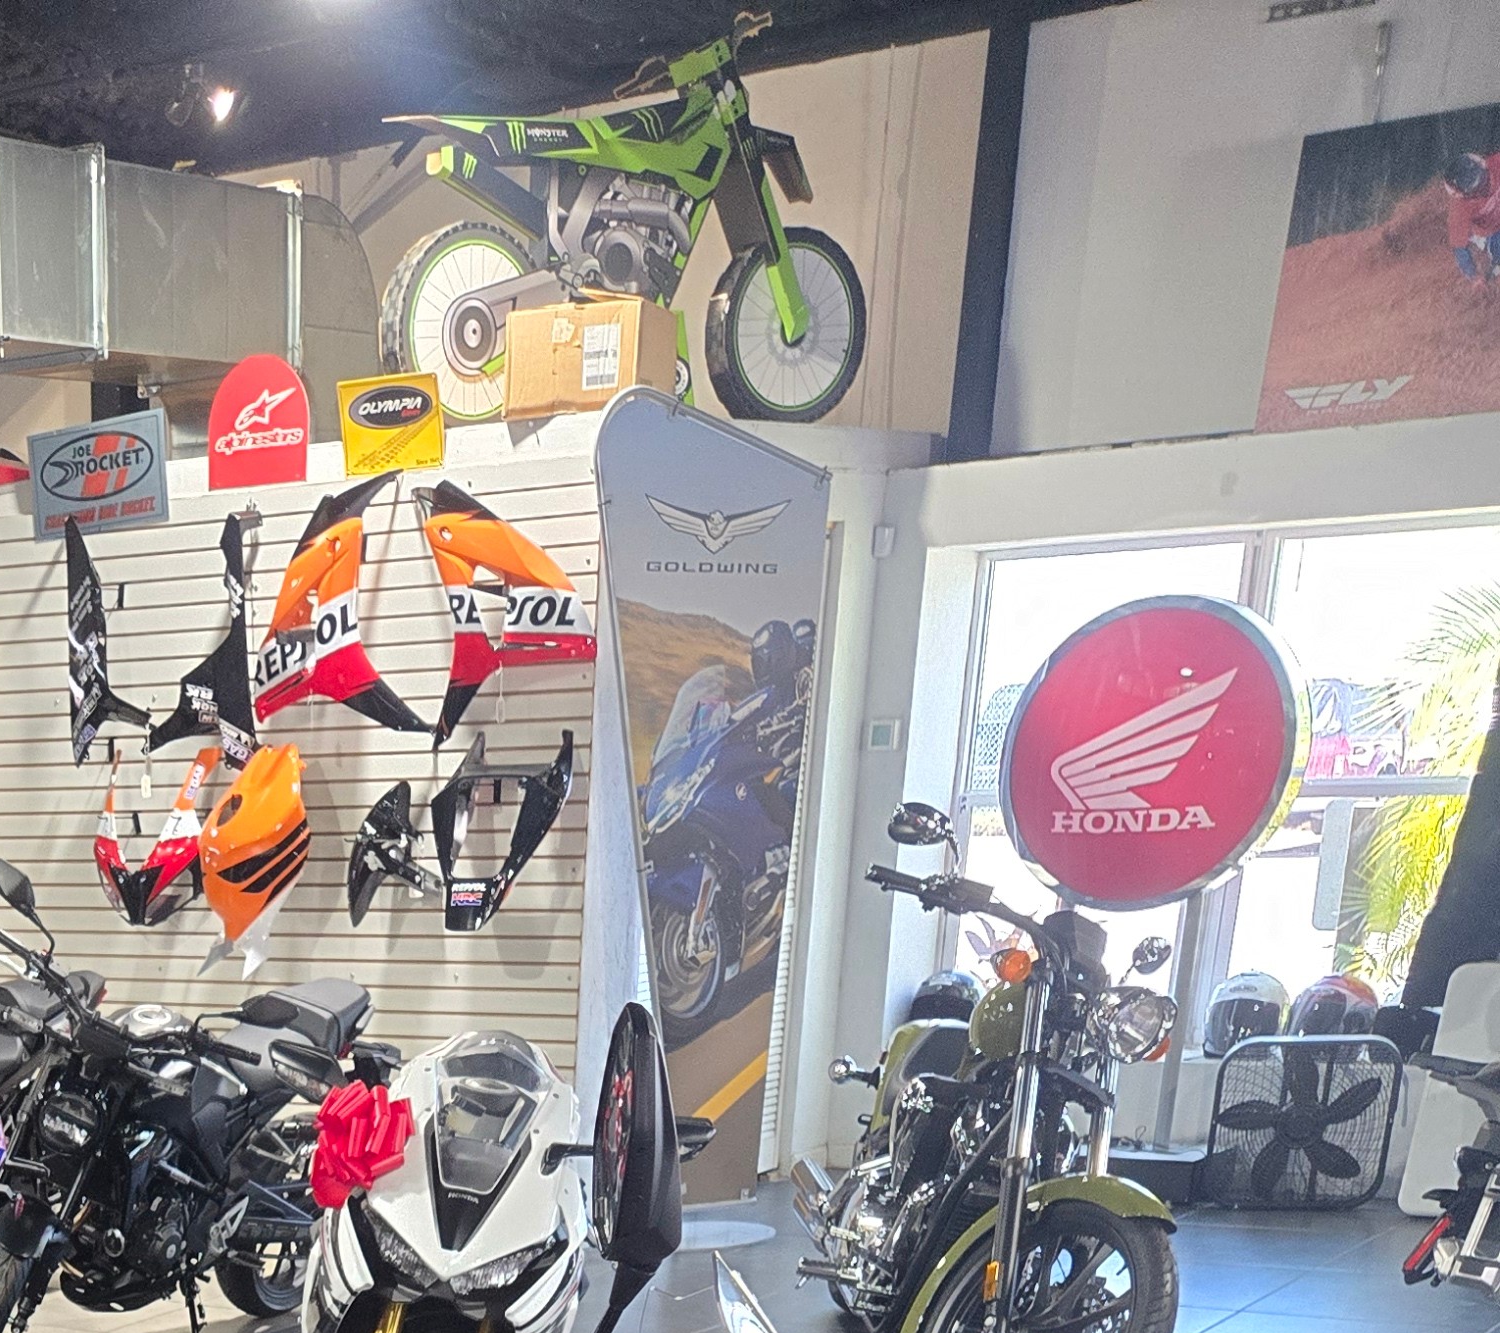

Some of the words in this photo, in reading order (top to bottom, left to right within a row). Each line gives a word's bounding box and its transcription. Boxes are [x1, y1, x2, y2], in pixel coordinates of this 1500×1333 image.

[527, 128, 568, 137] MONSTER
[1286, 375, 1413, 409] FLY
[358, 397, 423, 416] OLYMPIA
[71, 444, 92, 459] JOE
[75, 447, 145, 478] ROCKET
[646, 561, 778, 574] GOLDWING
[1051, 805, 1216, 834] HONDA
